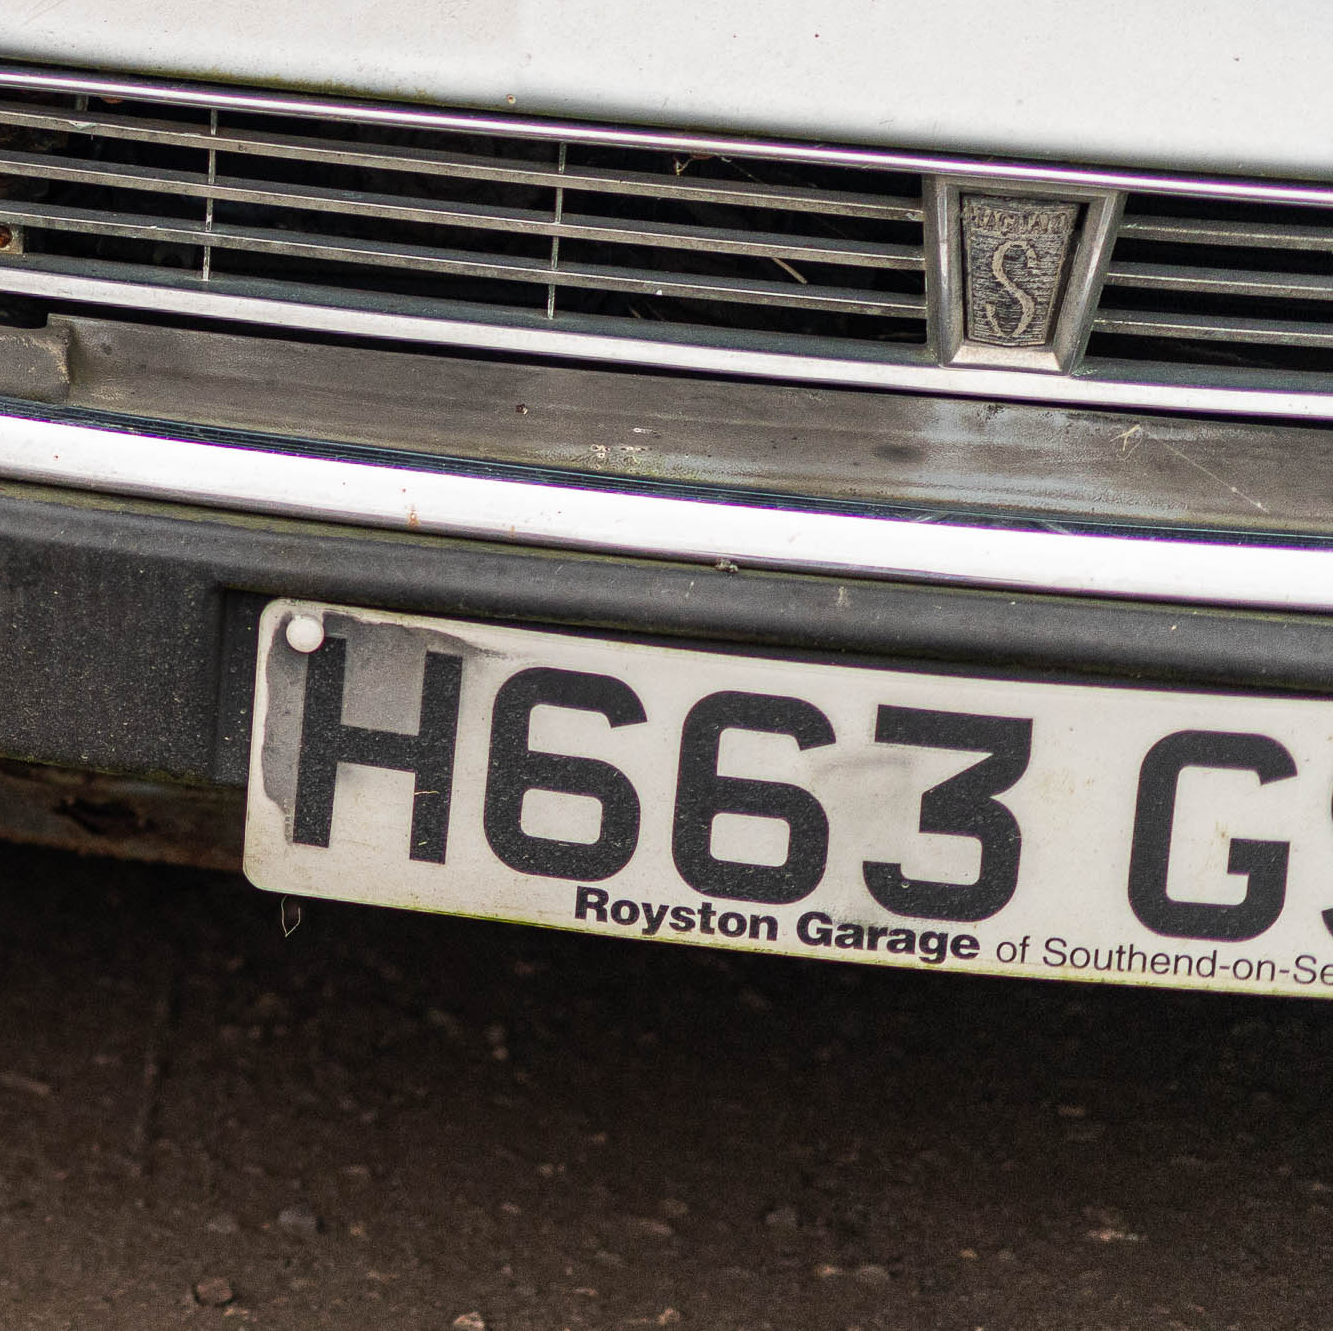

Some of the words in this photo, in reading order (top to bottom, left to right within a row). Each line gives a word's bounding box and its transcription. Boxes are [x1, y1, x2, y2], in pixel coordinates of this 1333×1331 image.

[985, 239, 1038, 337] S
[292, 636, 1034, 924] H663
[1128, 729, 1333, 944] G
[574, 885, 779, 942] Royston
[796, 910, 981, 964] Garage
[996, 935, 1030, 963] of
